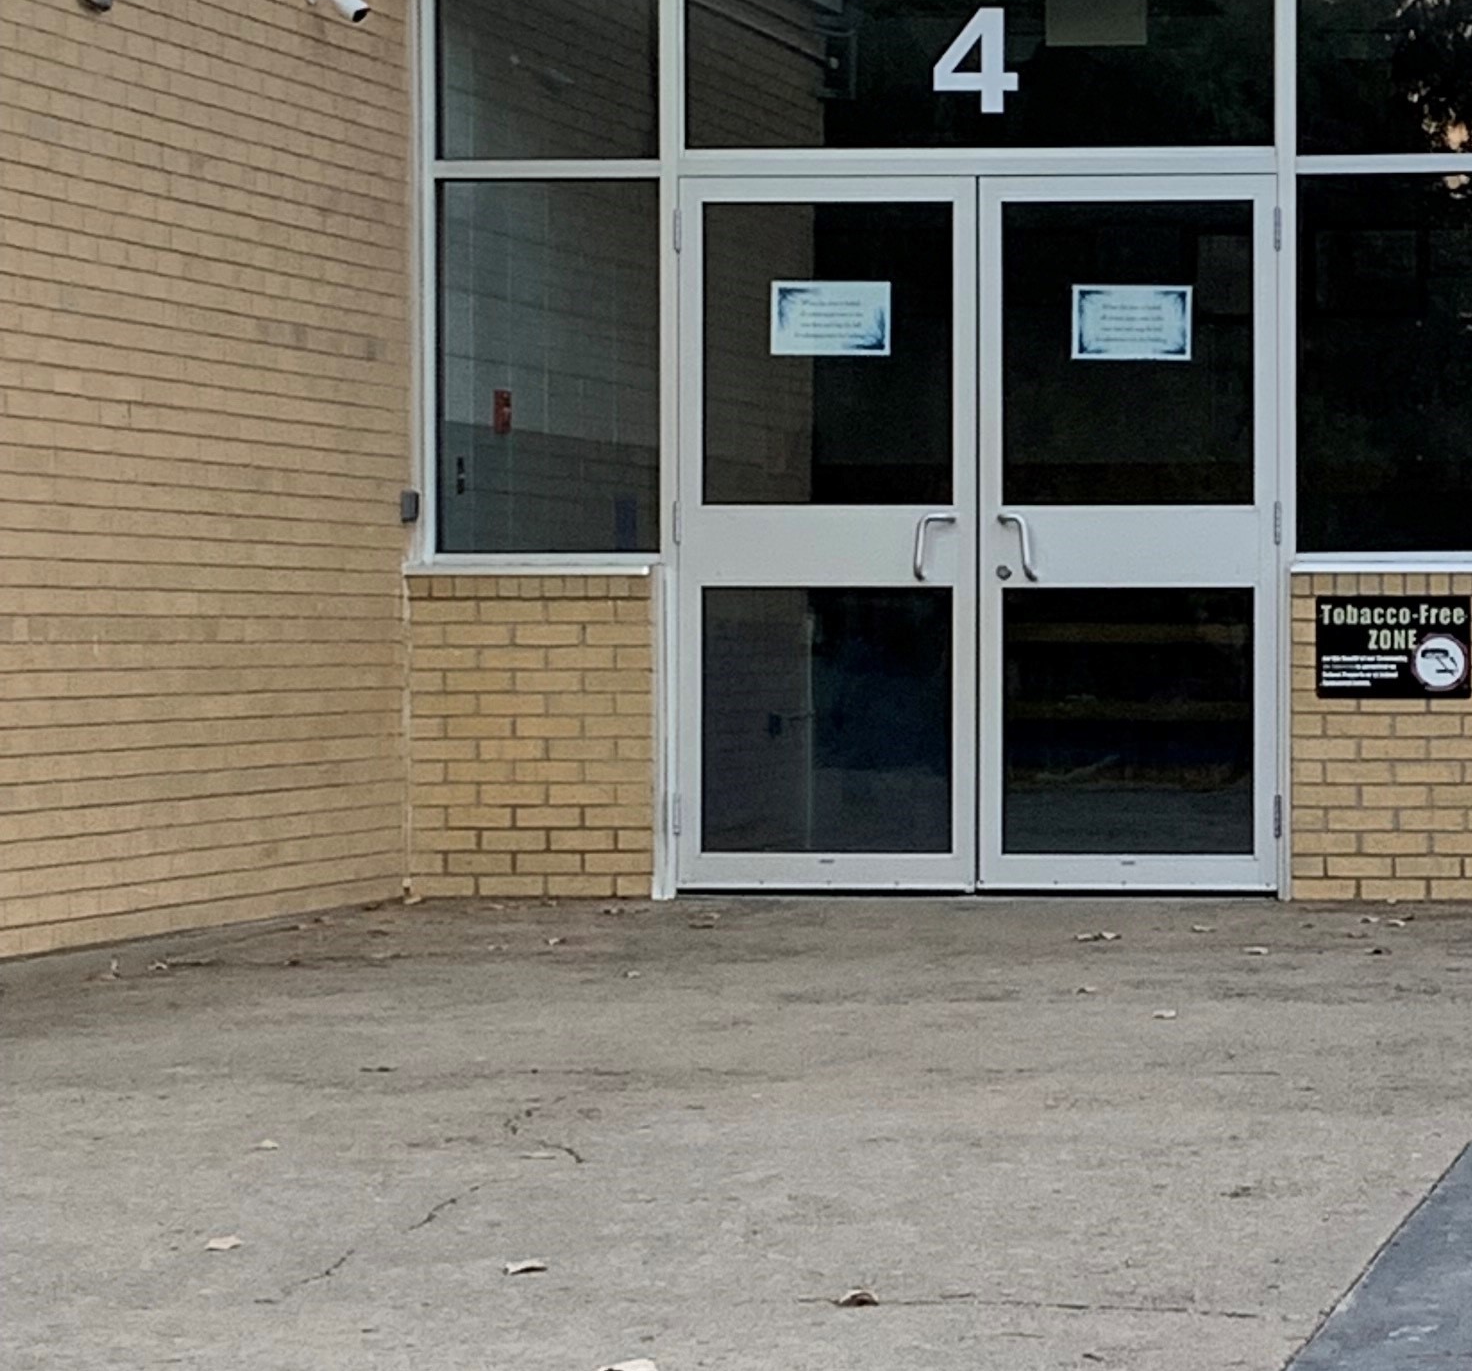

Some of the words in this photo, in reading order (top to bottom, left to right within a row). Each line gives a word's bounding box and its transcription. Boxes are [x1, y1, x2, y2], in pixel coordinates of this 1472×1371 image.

[933, 7, 1018, 113] 4
[1320, 604, 1466, 625] Tobacco-Free
[1368, 629, 1418, 650] ZONE
